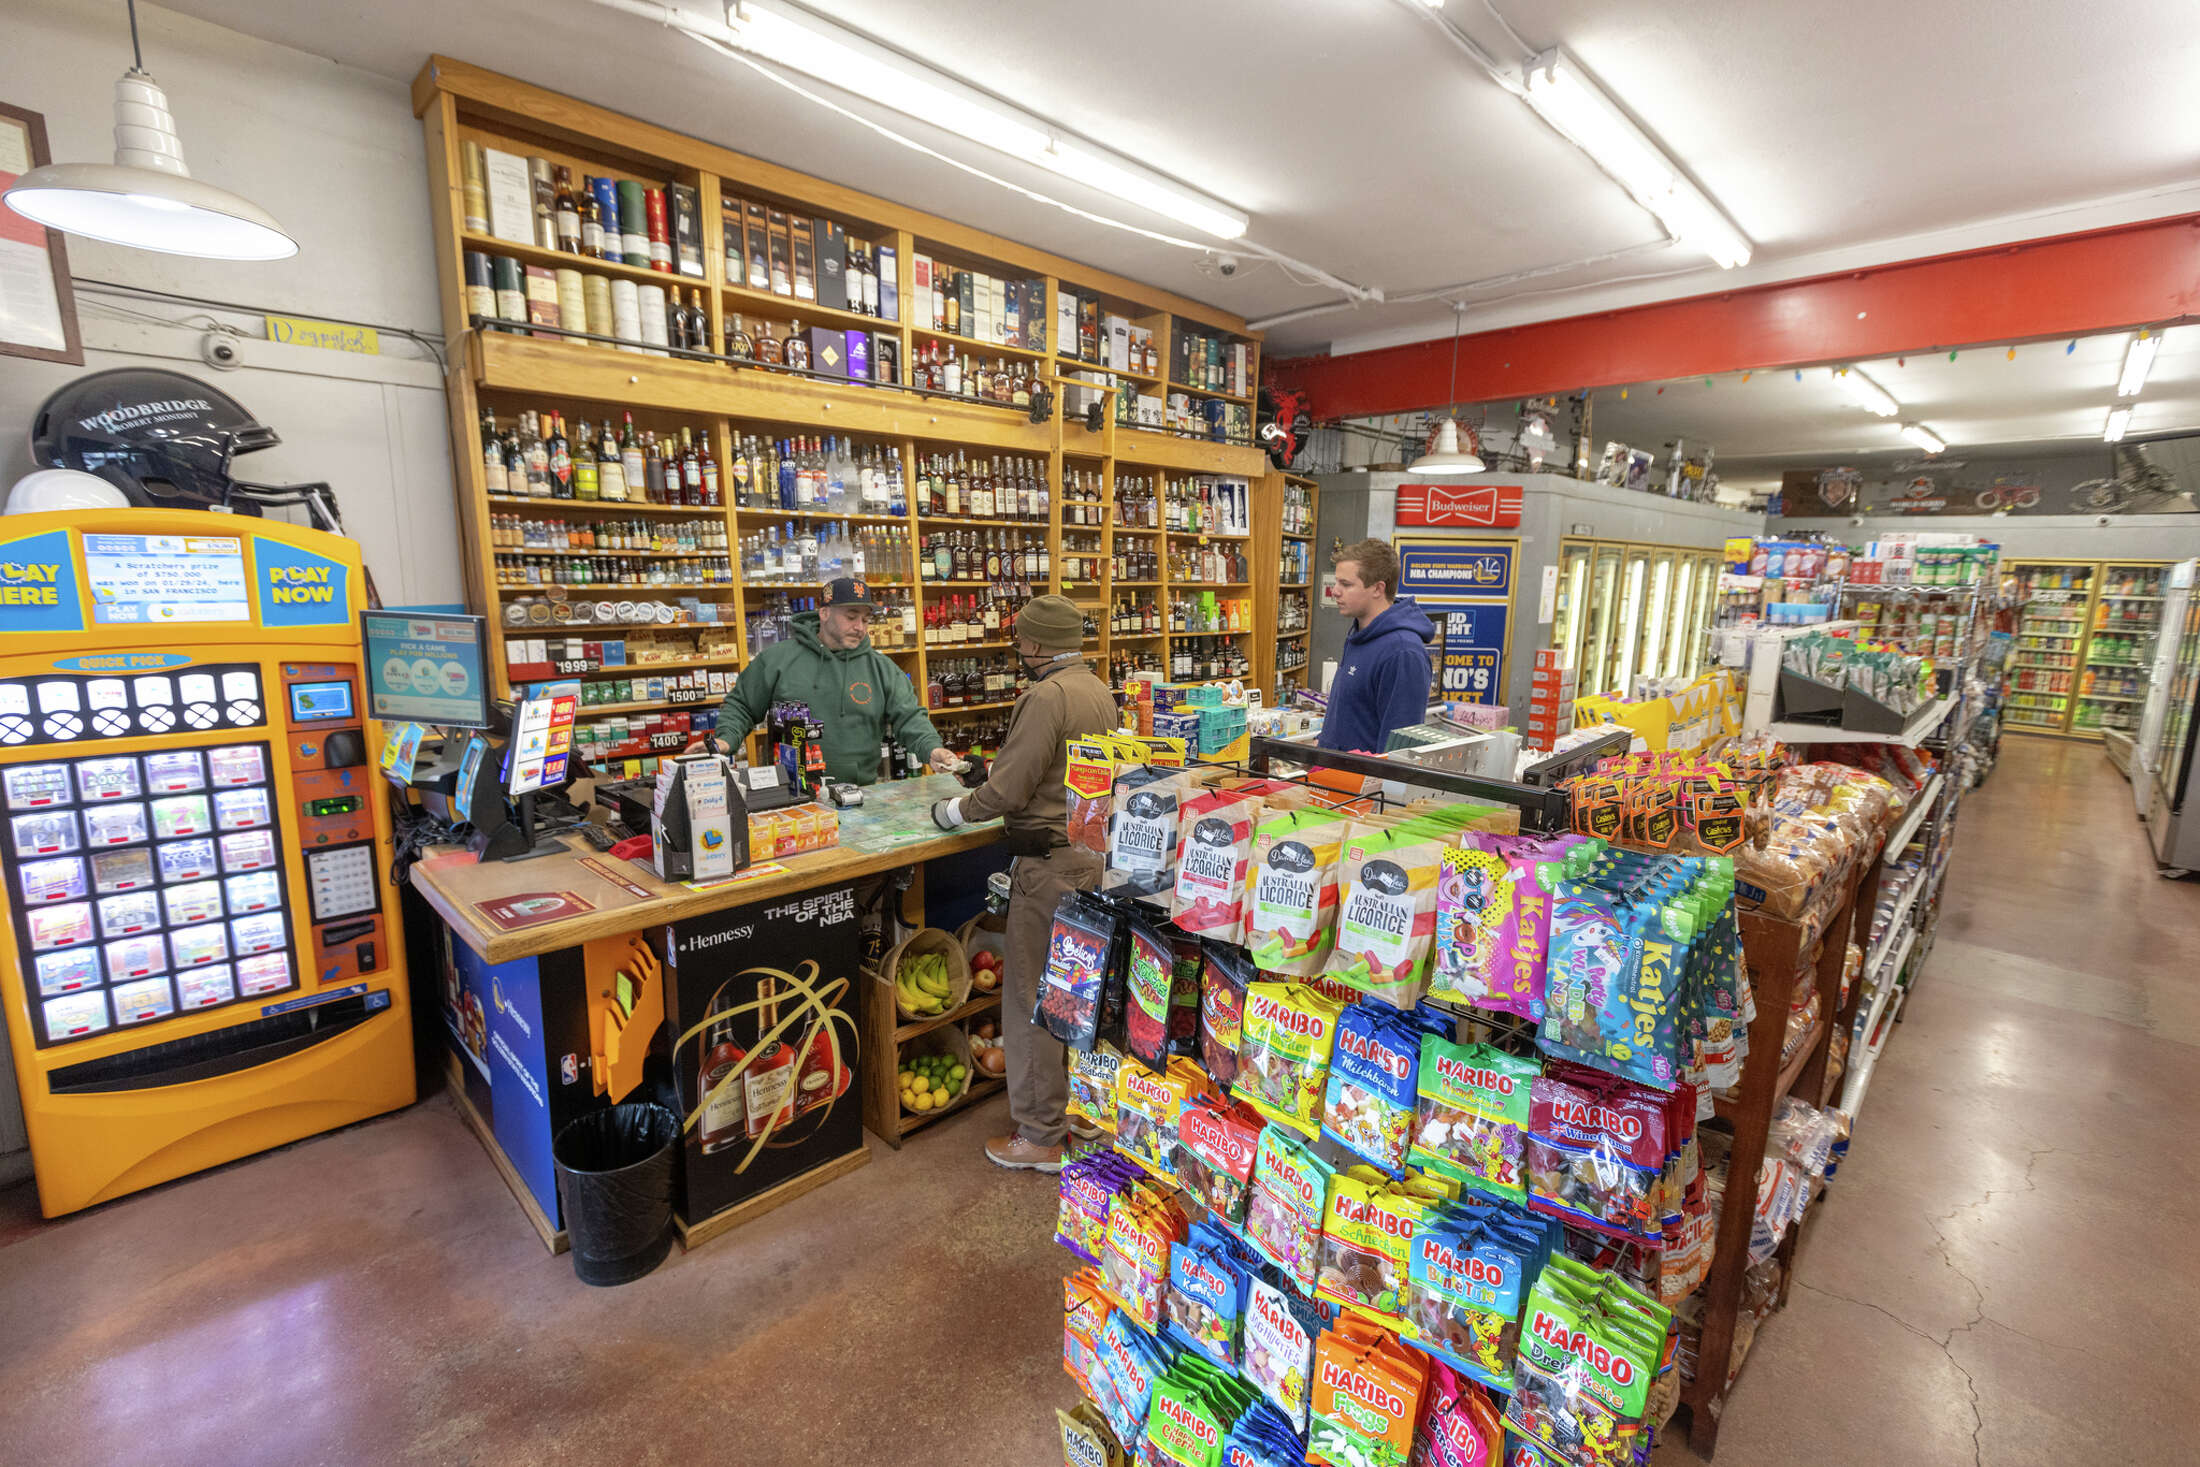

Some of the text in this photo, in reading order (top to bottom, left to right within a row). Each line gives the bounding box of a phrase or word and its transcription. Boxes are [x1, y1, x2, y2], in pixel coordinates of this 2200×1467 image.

[78, 399, 213, 431] WOODBRIDGE
[1431, 501, 1491, 512] Budweiser
[0, 563, 60, 583] LAY
[1410, 569, 1473, 580] NBA CHAMPIONS
[272, 586, 334, 603] NOW
[80, 655, 166, 669] QUICK PICK
[1119, 831, 1163, 851] LICORICE
[1122, 821, 1164, 837] AUSTRALIAN
[1185, 858, 1231, 881] LICORICE
[1188, 848, 1233, 867] AUSTRALIAN
[1259, 886, 1313, 909] LICORICE
[1261, 875, 1315, 894] AUSTRALIAN
[764, 888, 854, 920] THE SPIRIT
[795, 899, 854, 923] OF THE
[819, 910, 855, 927] NBA
[1354, 894, 1409, 920] AUSTRALIAN
[1347, 906, 1407, 935] LICORICE
[1437, 910, 1453, 951] MIX
[689, 924, 755, 951] Hennessy
[1510, 894, 1545, 994] Katjes
[1299, 976, 1363, 1004] HARIB
[1553, 960, 1569, 1007] LAND
[1630, 939, 1673, 1048] Katjes
[1253, 995, 1325, 1039] HARIBO
[1128, 1074, 1172, 1105] HARBO
[1436, 1054, 1515, 1097] HARIBO
[1552, 1096, 1642, 1141] HARIBO
[1565, 1127, 1597, 1141] Wine
[1191, 1115, 1241, 1160] HARIBO
[1068, 1169, 1107, 1205] HARIBO
[1265, 1150, 1313, 1203] HARO
[1335, 1193, 1414, 1239] HARIBO
[1181, 1256, 1226, 1297] HARIBO
[1423, 1238, 1503, 1287] HARIBO
[1427, 1264, 1463, 1293] Bunte
[1255, 1290, 1304, 1352] HARIBO
[1107, 1329, 1147, 1394] HARIBO
[1532, 1309, 1636, 1387] HARIBO
[1322, 1360, 1405, 1418] HARIBO
[1159, 1395, 1218, 1447] HARIBO
[1333, 1392, 1389, 1434] Frogs
[1065, 1426, 1103, 1467] HARIBO
[1162, 1423, 1206, 1463] Cherries
